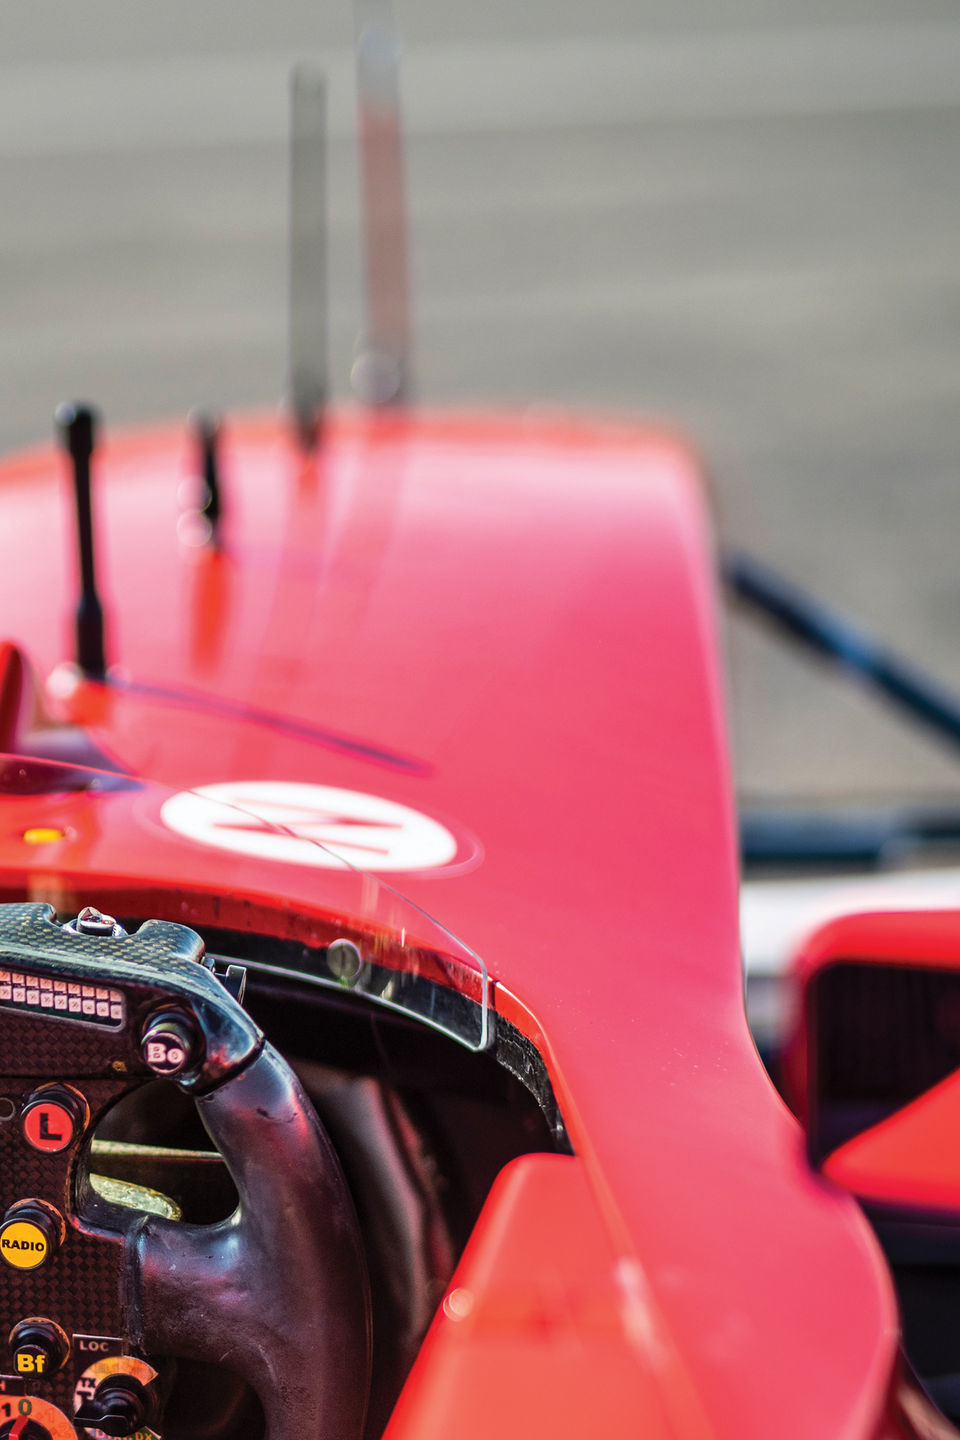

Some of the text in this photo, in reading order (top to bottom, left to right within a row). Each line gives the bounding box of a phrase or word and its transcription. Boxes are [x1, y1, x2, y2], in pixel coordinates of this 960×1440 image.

[146, 1042, 185, 1064] Bo
[39, 1113, 63, 1141] L
[1, 1237, 45, 1252] RADIO
[79, 1340, 110, 1352] LOC
[16, 1353, 46, 1373] Bf
[18, 1399, 33, 1416] 0
